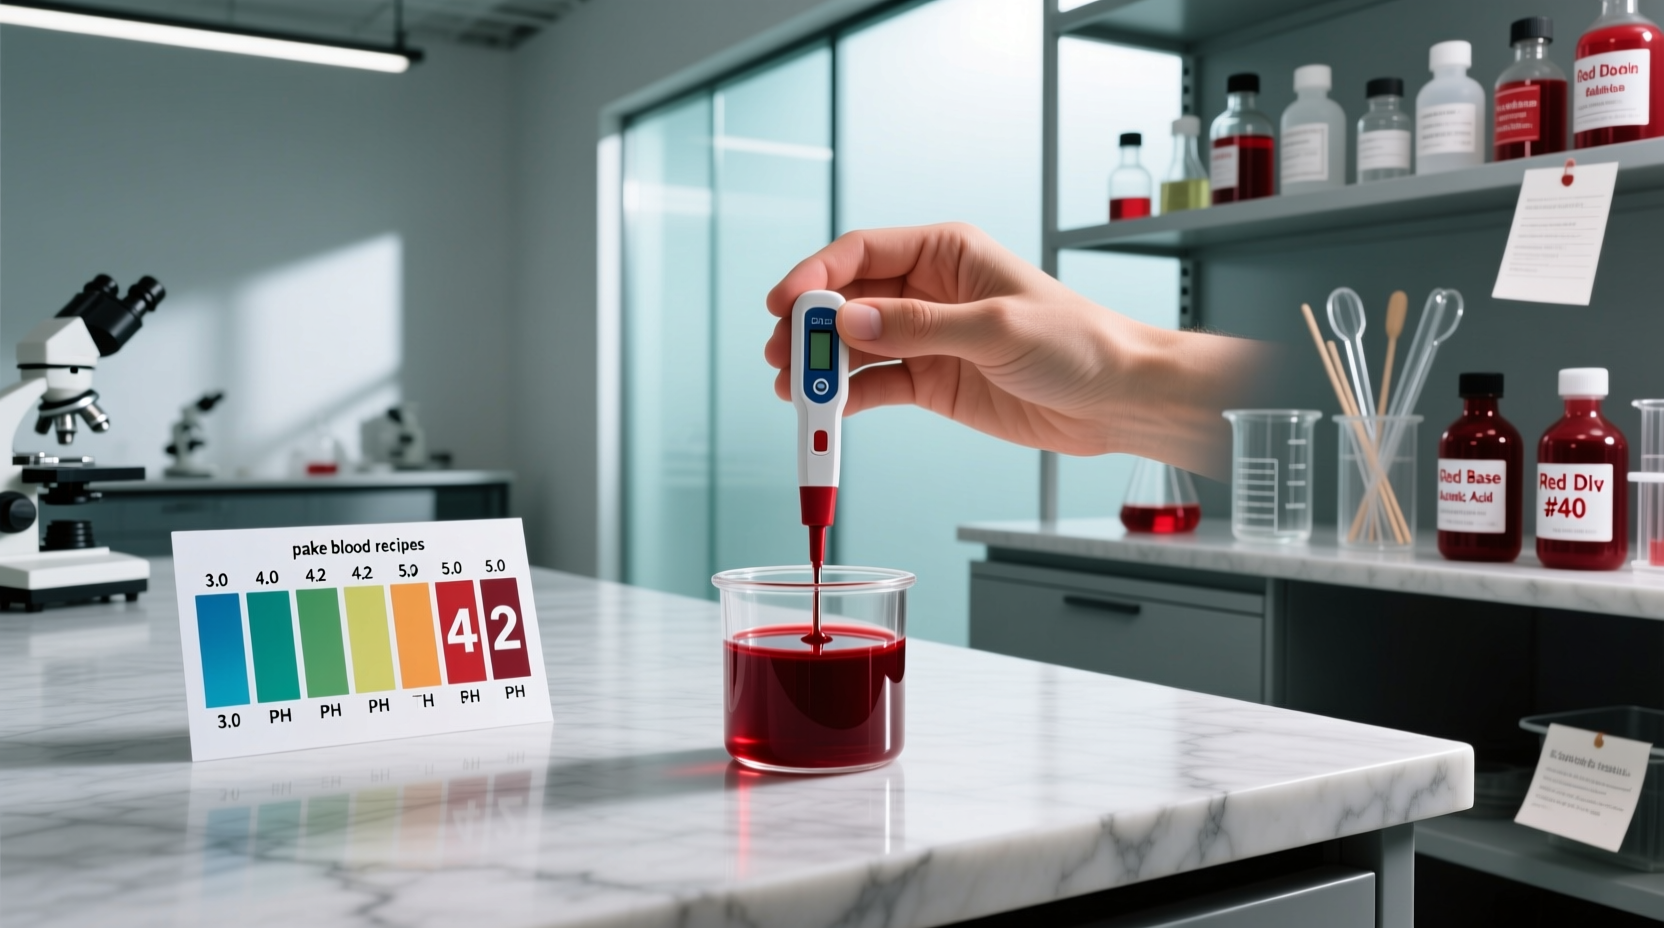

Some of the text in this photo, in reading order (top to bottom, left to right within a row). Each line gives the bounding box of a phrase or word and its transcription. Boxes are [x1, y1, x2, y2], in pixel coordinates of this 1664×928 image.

[1467, 469, 1502, 484] Base
[1539, 473, 1567, 490] Red
[1544, 496, 1586, 519] #40
[293, 537, 425, 560] pake blood recipes
[205, 559, 506, 588] 3.0 4.0 4.2 4.2 5.0 5.0 5.0
[217, 712, 241, 728] 3.0
[269, 708, 292, 723] PH
[320, 703, 342, 718] PH
[368, 698, 390, 713] PH
[504, 684, 526, 699] PH
